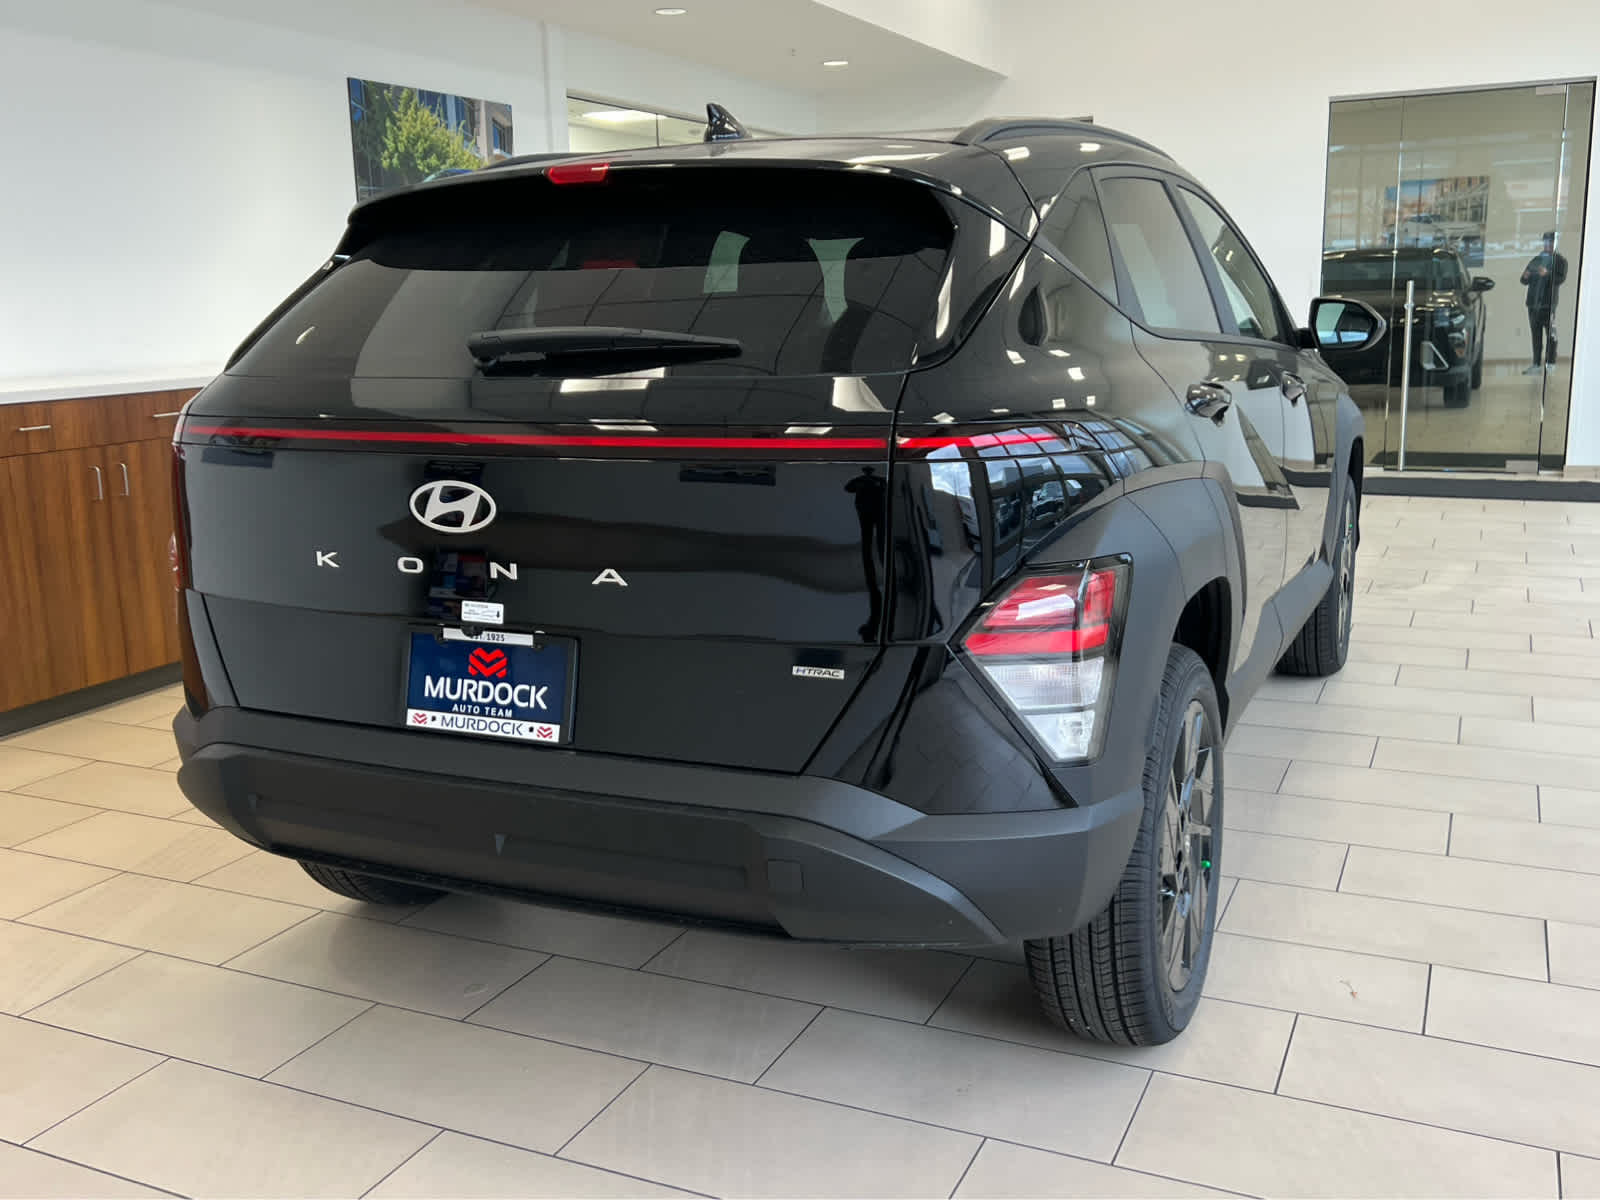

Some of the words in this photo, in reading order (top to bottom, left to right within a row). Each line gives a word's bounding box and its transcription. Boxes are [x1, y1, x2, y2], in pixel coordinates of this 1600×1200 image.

[316, 551, 628, 587] KONA
[487, 633, 505, 642] 1925
[796, 667, 841, 678] HTRAC
[424, 675, 548, 710] MURDOCK
[452, 703, 480, 715] AUTO
[484, 706, 513, 718] TEAM
[441, 715, 523, 736] MURDOCK
